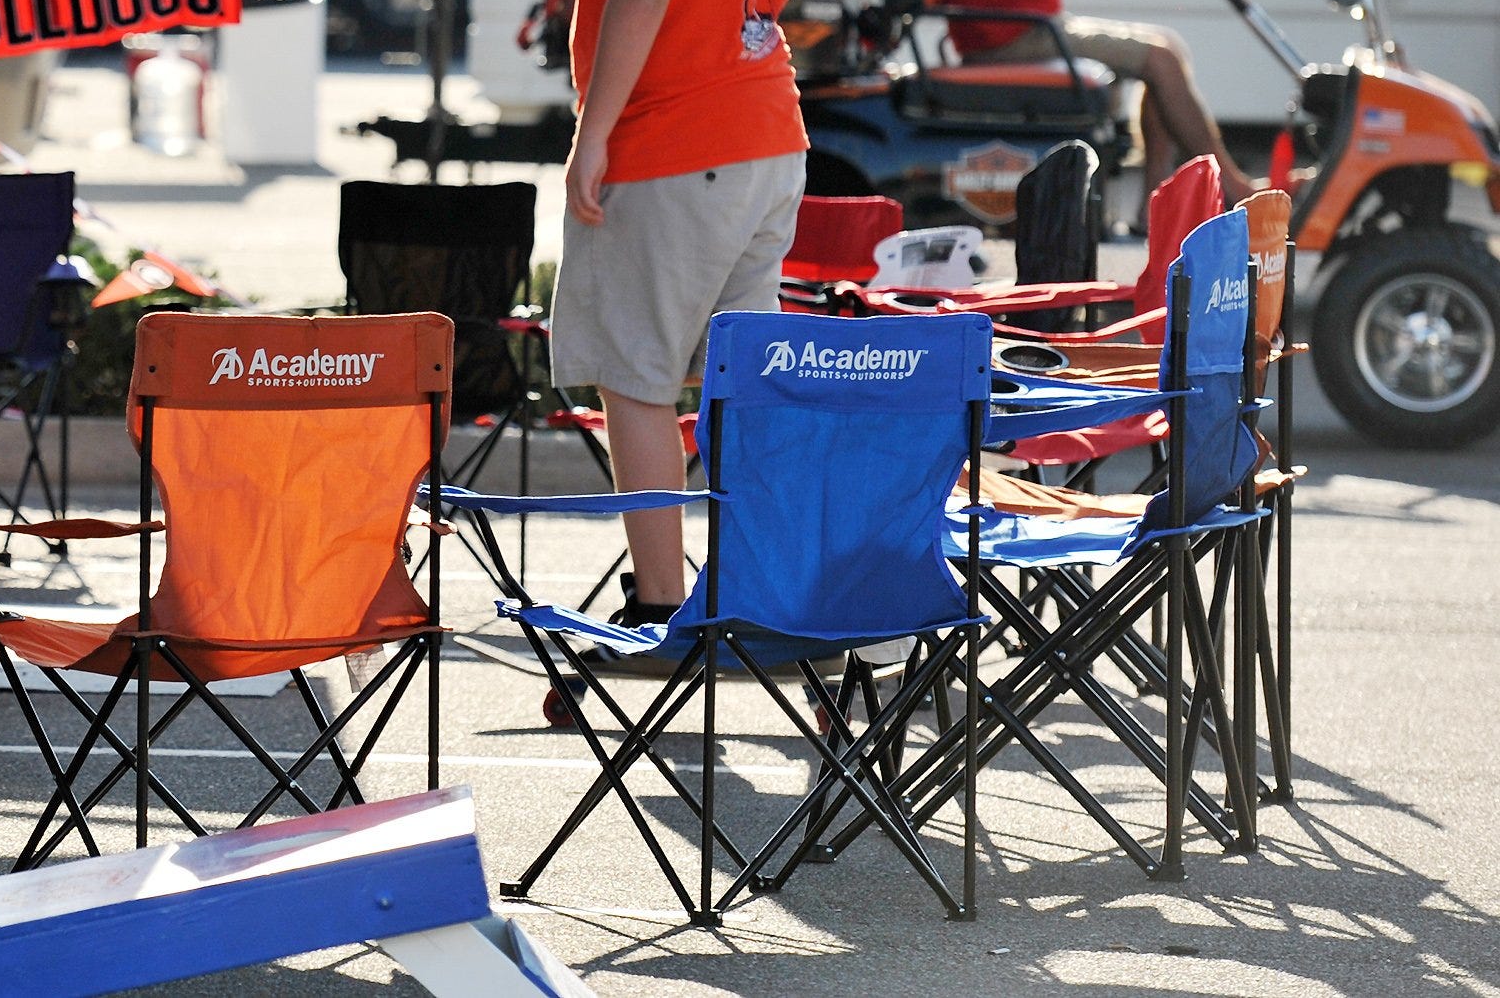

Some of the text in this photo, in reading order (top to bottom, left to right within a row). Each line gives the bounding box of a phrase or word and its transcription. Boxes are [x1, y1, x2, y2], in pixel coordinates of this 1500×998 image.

[1221, 272, 1249, 302] Acad
[248, 348, 377, 383] Academy
[799, 341, 922, 377] Academy
